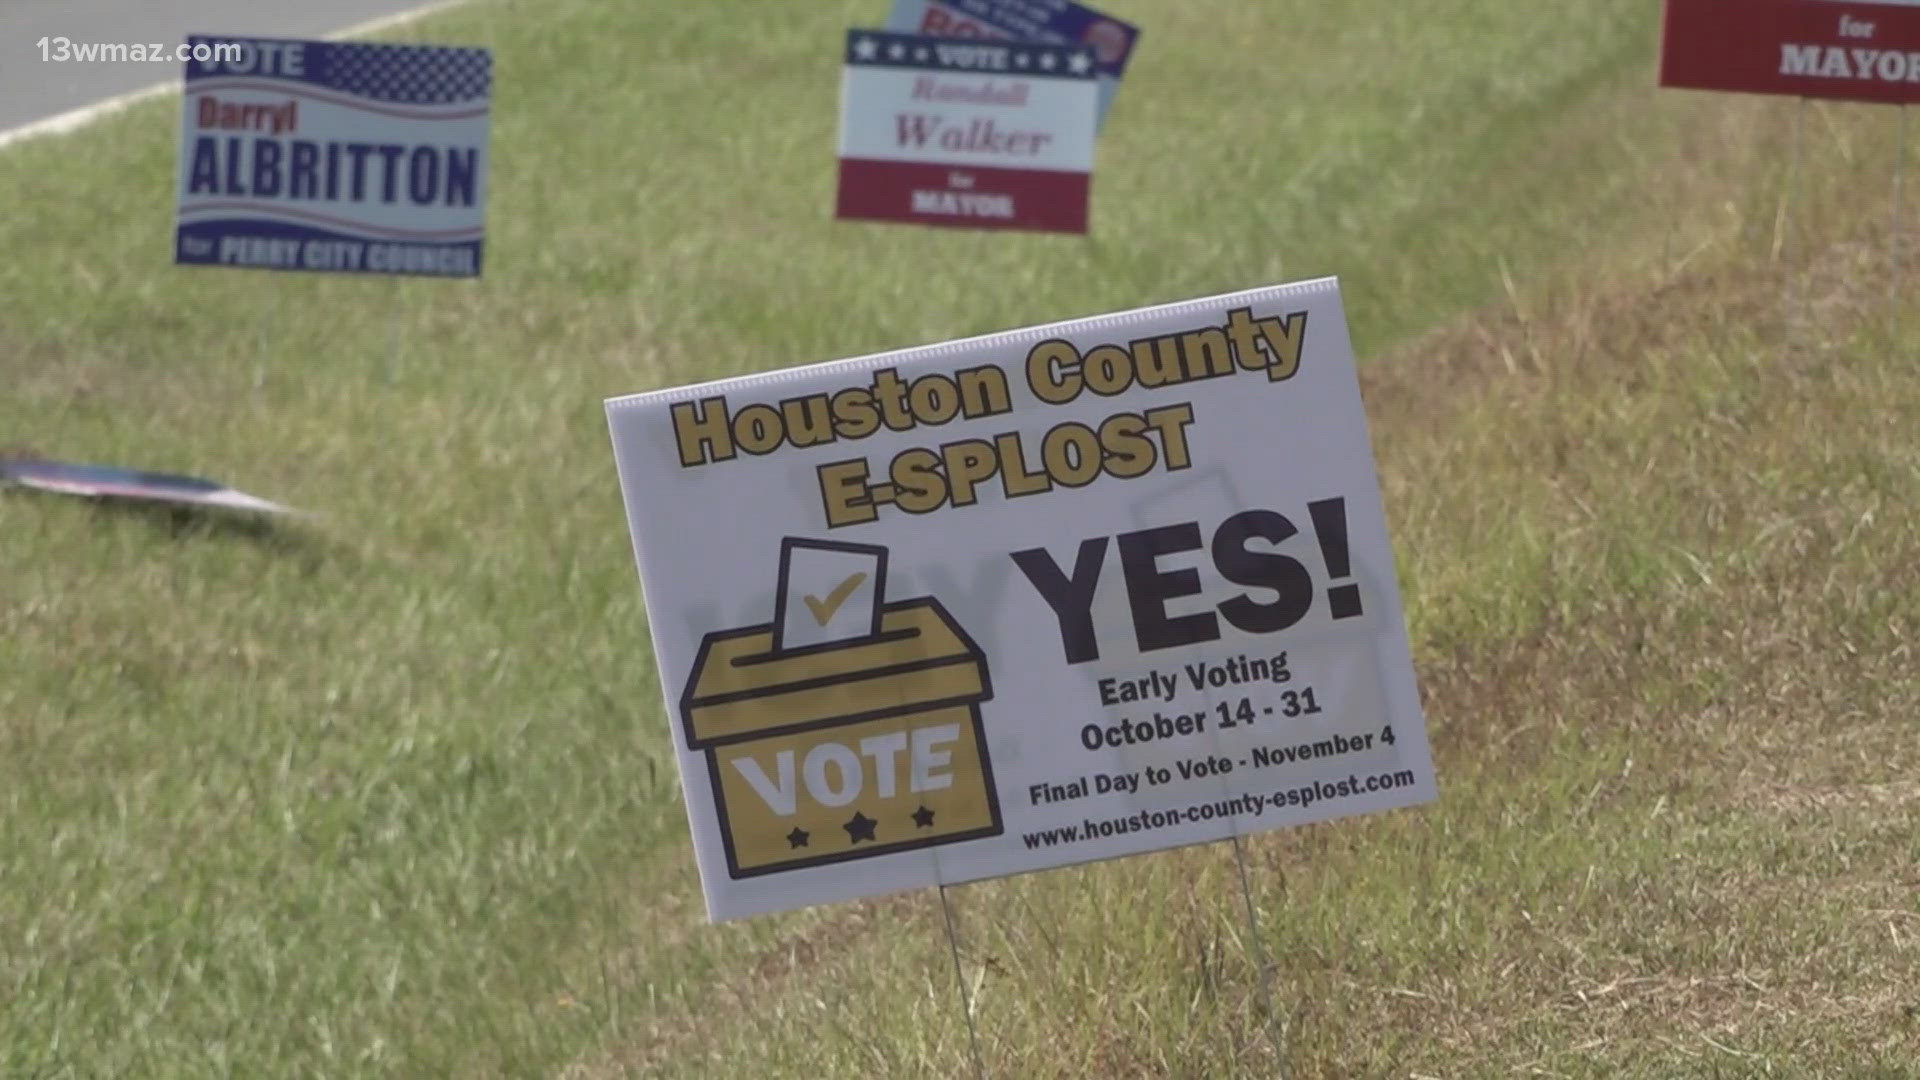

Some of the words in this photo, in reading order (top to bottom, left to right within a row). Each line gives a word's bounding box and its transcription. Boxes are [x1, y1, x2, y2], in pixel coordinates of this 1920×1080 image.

[1838, 14, 1876, 38] for
[194, 40, 304, 75] VOTE
[935, 44, 1009, 70] VOTE
[198, 95, 298, 134] Darryl
[895, 114, 1052, 156] Walker
[189, 137, 480, 208] ALBRITTON
[911, 190, 1014, 219] MAYOR
[218, 236, 300, 269] PERRY
[302, 241, 365, 271] CITY
[366, 244, 476, 275] COUNCIL
[670, 364, 1011, 468] Houston
[1025, 306, 1309, 405] County
[817, 403, 1195, 529] E-SPLOST
[1009, 496, 1364, 666] YES!
[1098, 670, 1178, 706] Early
[1185, 651, 1292, 691] Voting
[1081, 709, 1207, 751] October
[1216, 698, 1256, 729] 14
[1282, 687, 1322, 717] 31
[731, 722, 961, 817] VOTE
[1029, 777, 1089, 805] Final
[1095, 770, 1140, 794] Day
[1146, 765, 1171, 787] to
[1176, 755, 1233, 781] Vote
[1252, 733, 1374, 769] November
[1380, 725, 1396, 746] 4
[1022, 768, 1415, 850] www.houston-county-esplost.com
